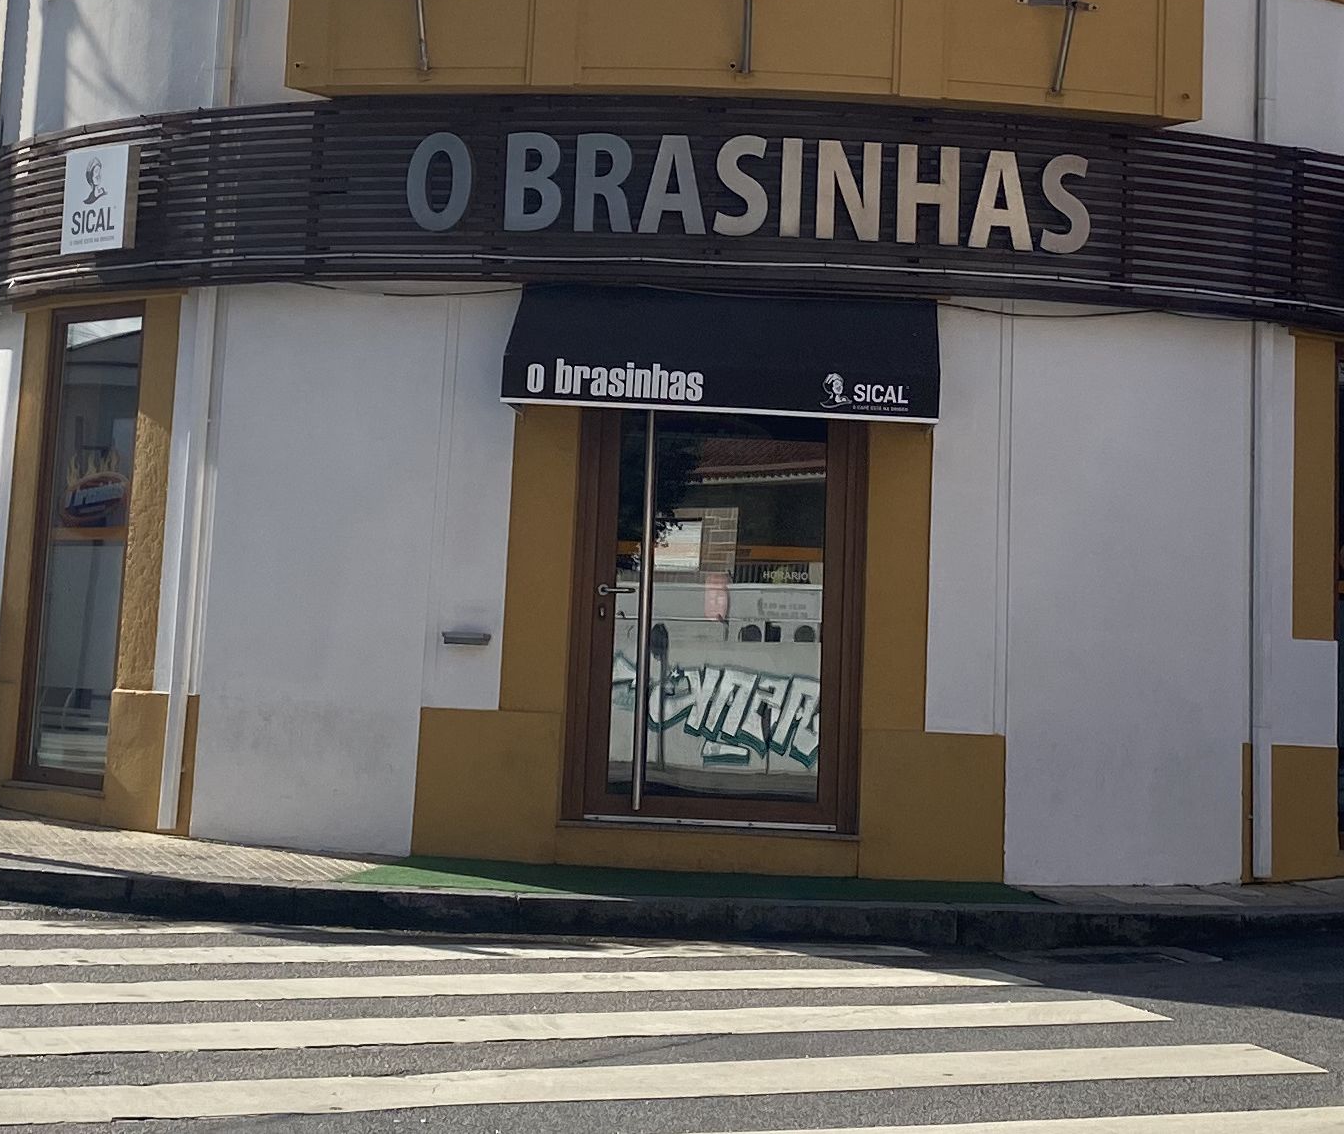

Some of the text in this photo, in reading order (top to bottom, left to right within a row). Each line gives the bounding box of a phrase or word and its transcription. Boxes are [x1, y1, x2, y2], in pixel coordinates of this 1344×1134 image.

[406, 131, 1091, 255] O BRASINHAS
[71, 206, 115, 236] SICAL
[526, 358, 704, 402] o brasinhas
[853, 383, 909, 404] SICAL
